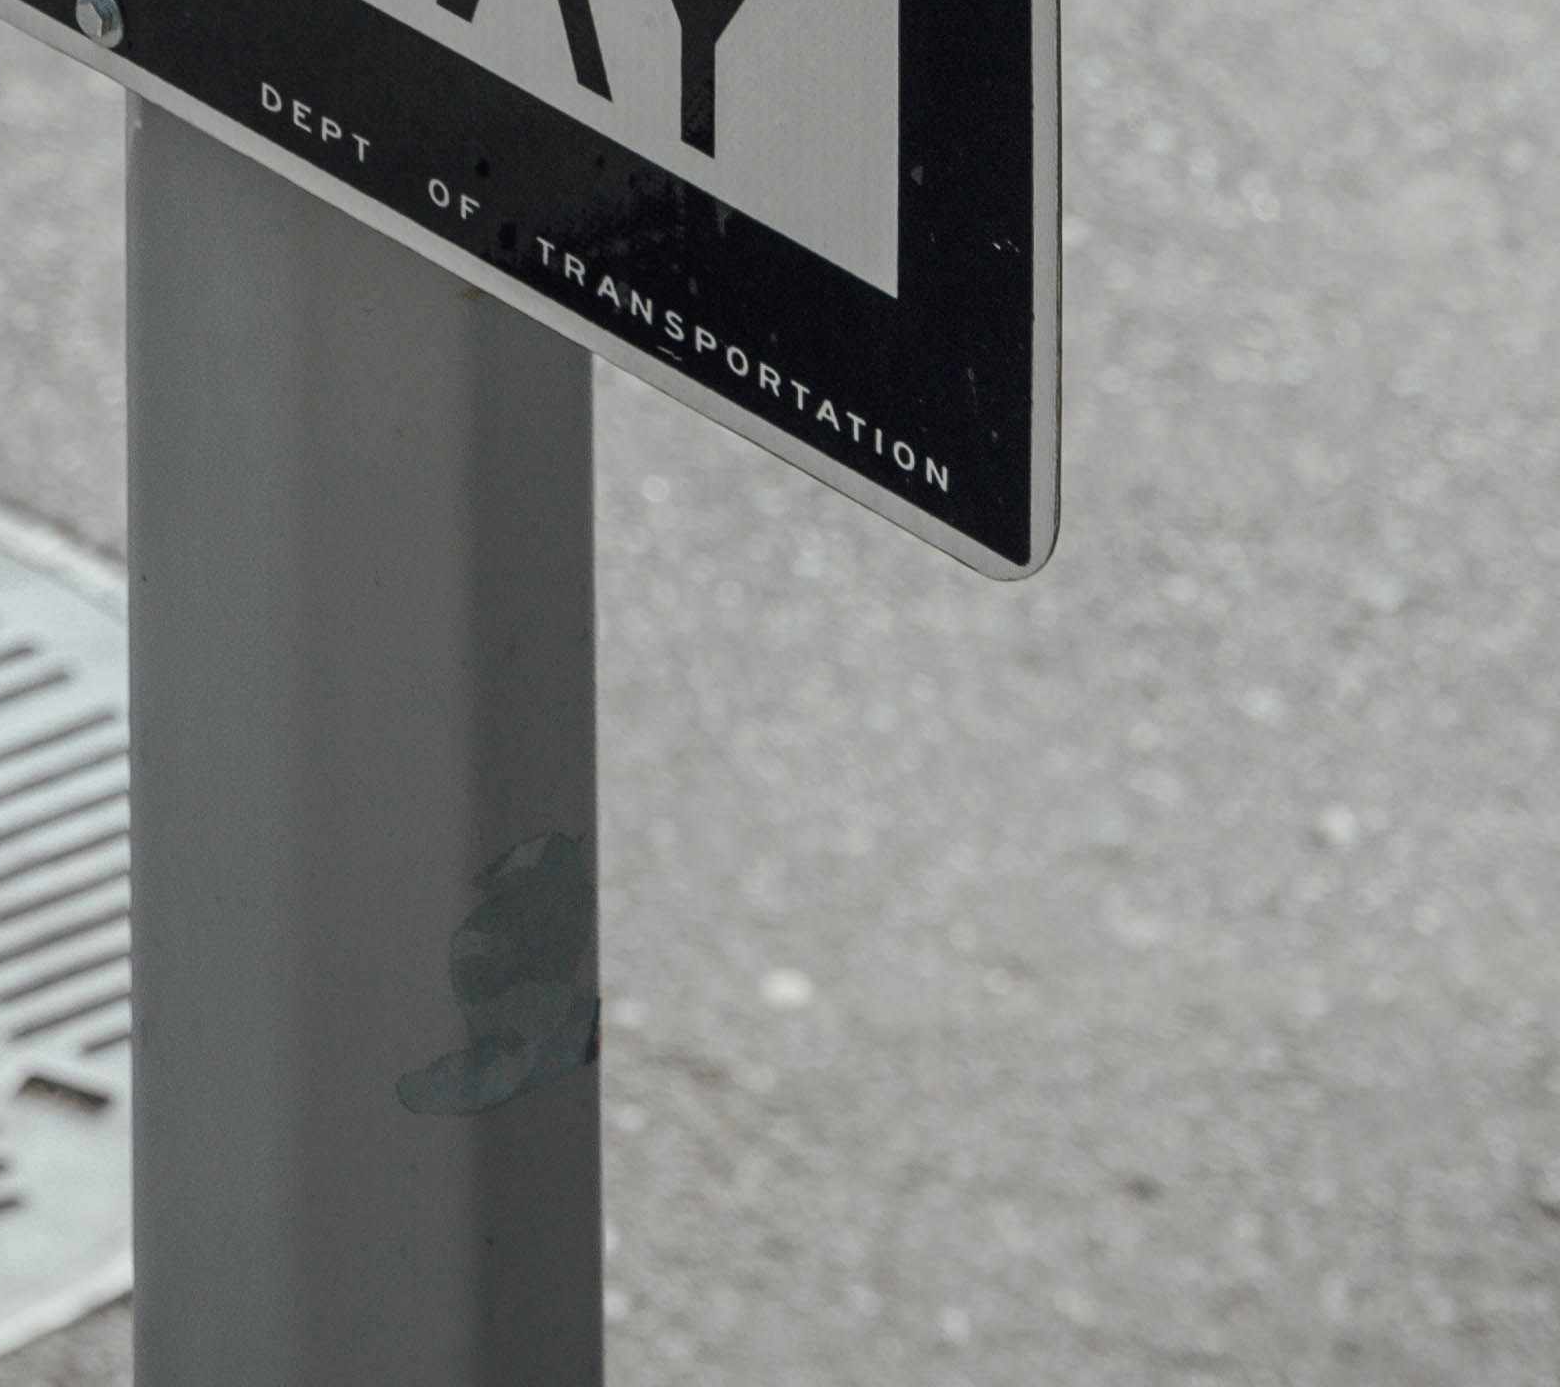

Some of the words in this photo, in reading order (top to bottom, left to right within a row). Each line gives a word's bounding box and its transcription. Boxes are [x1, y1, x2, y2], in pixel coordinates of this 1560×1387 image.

[261, 81, 372, 164] DEPT
[427, 178, 482, 222] OF
[536, 235, 952, 494] TRANSPORTATION
